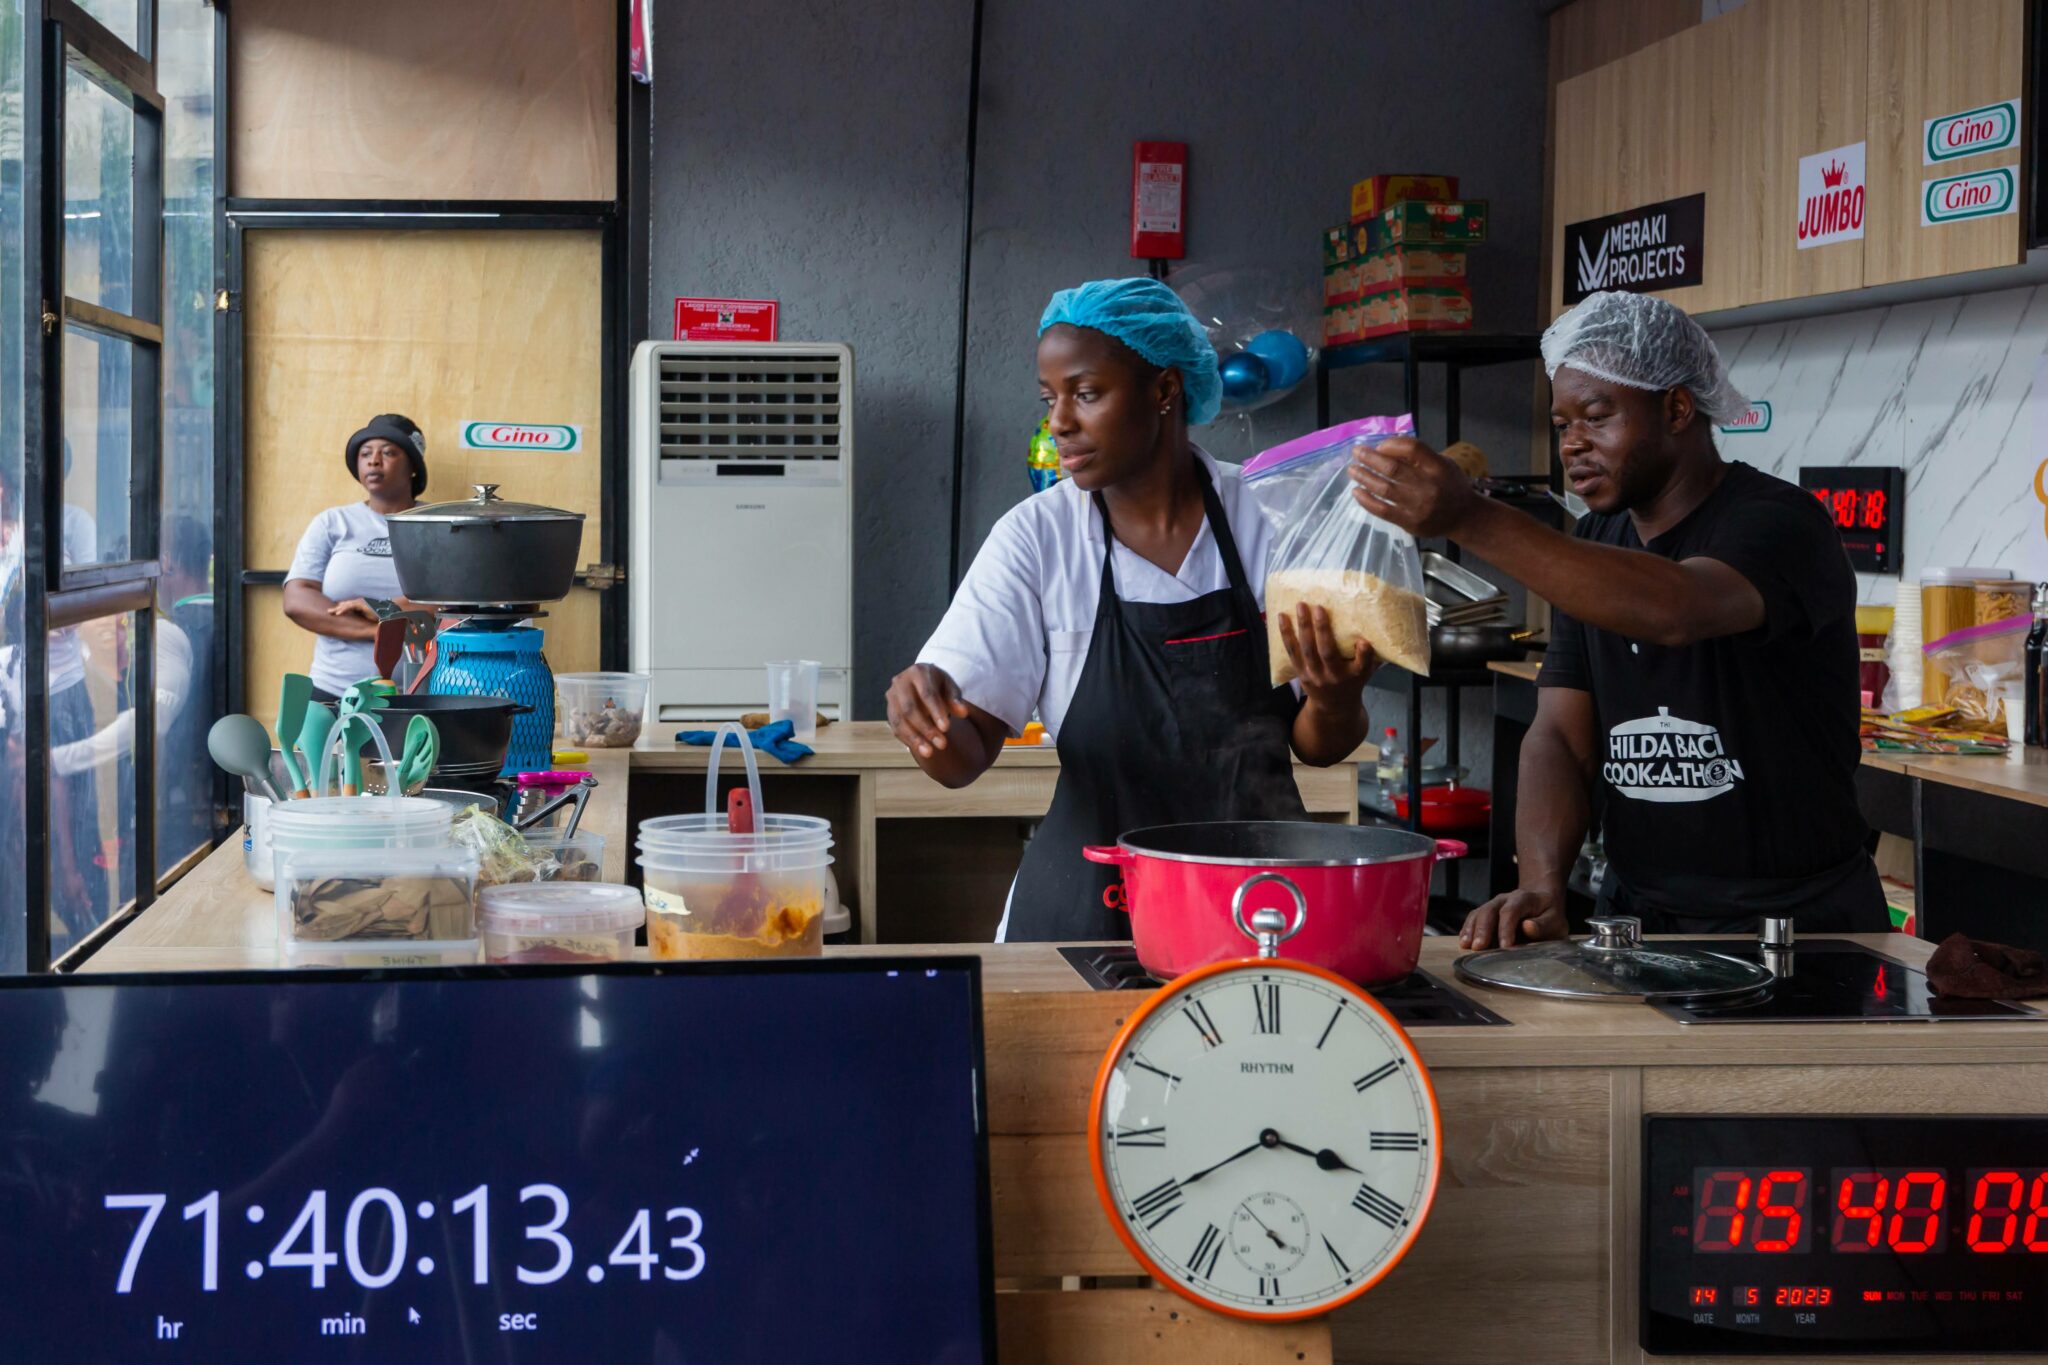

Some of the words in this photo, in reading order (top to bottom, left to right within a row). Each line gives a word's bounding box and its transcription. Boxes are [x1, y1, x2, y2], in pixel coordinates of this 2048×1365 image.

[1947, 118, 1993, 147] Gino
[1945, 181, 1991, 209] Gino
[1798, 185, 1865, 240] JUMBO
[1610, 214, 1667, 254] MERAKI
[1609, 245, 1685, 286] PROJECTS
[492, 427, 550, 444] Gino
[1832, 489, 1857, 528] 40
[1864, 490, 1885, 529] 18
[1610, 734, 1675, 760] HILDA
[1675, 733, 1724, 759] BACI
[1603, 760, 1745, 787] COOK-A-THN
[1252, 984, 1282, 1034] XII
[1240, 1062, 1294, 1075] RHYTHM
[1353, 1059, 1400, 1093] II
[1369, 1131, 1419, 1152] III
[1727, 1170, 1804, 1252] 15
[1837, 1171, 1946, 1253] 40
[1186, 1223, 1227, 1280] VII
[1694, 1287, 1716, 1304] 14
[1747, 1287, 1758, 1305] 5
[1776, 1287, 1831, 1305] 2023
[1863, 1290, 1882, 1300] SUN
[157, 1316, 184, 1338] hr
[321, 1313, 365, 1335] min
[499, 1311, 537, 1332] sec
[1693, 1313, 1714, 1324] DATE
[1735, 1313, 1760, 1324] MONTH
[1794, 1313, 1817, 1324] YEAR
